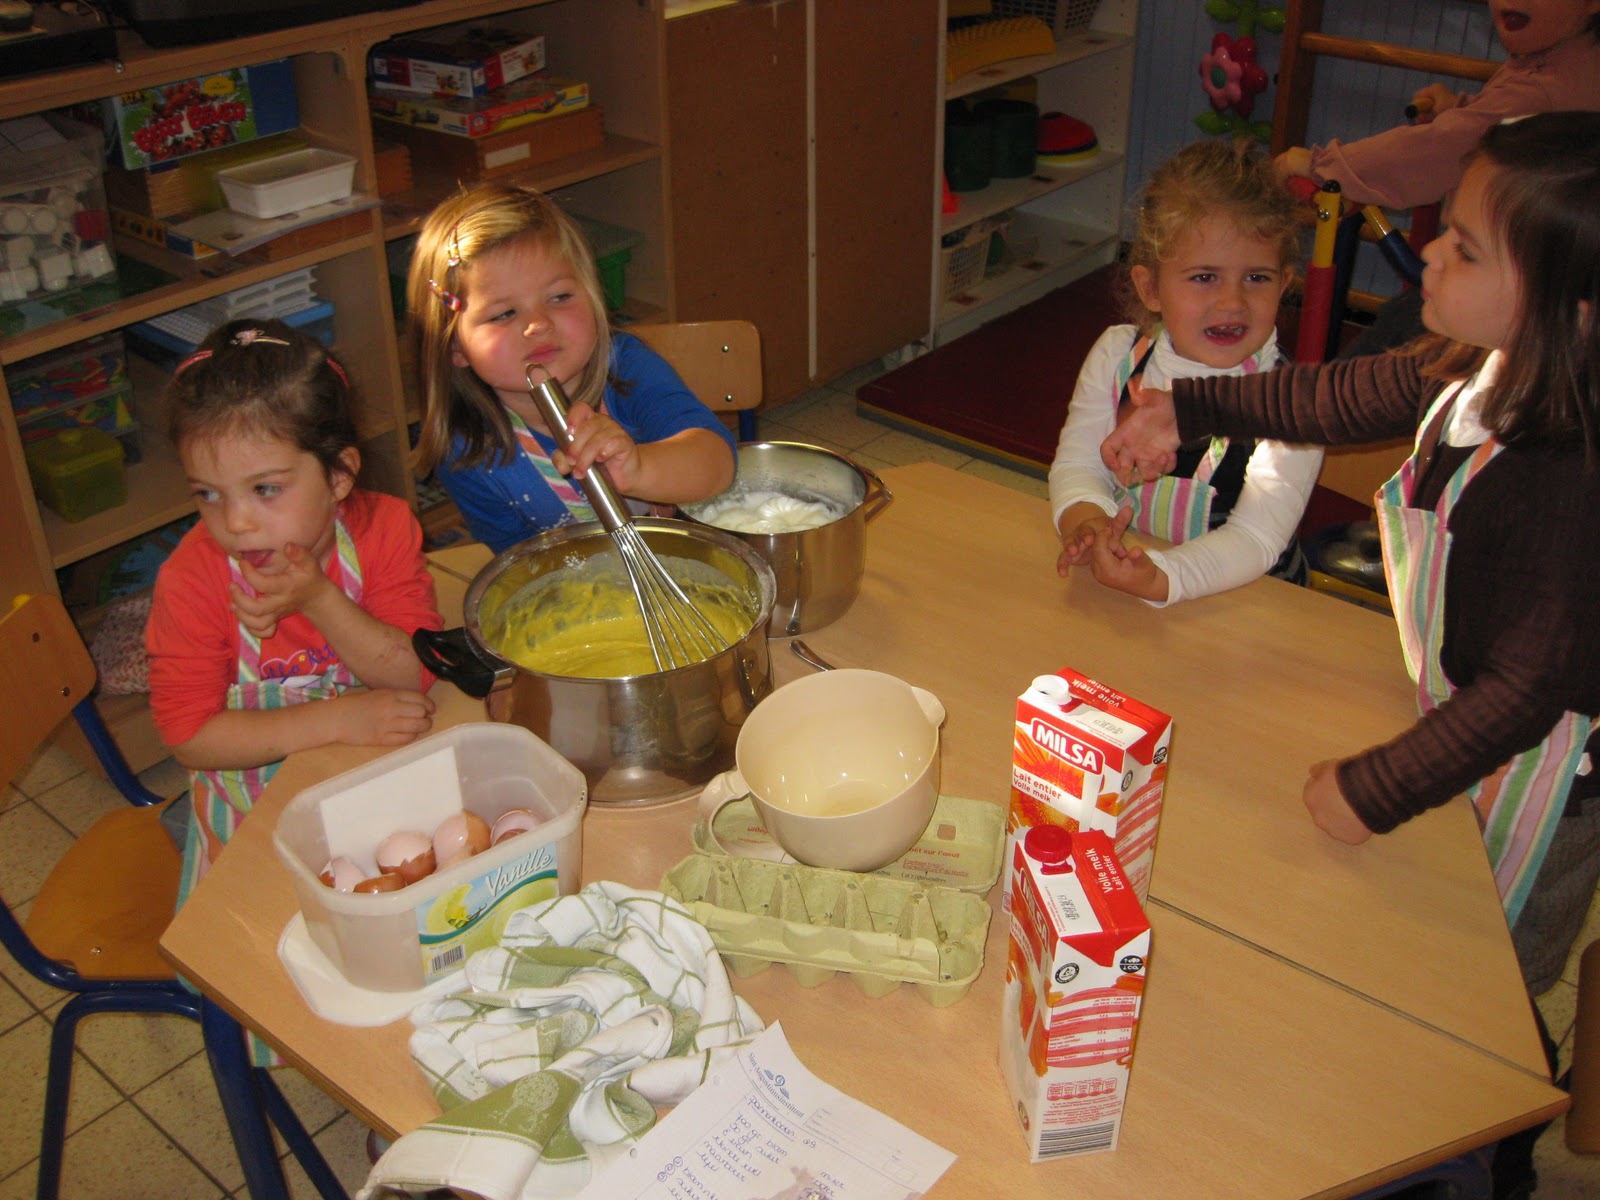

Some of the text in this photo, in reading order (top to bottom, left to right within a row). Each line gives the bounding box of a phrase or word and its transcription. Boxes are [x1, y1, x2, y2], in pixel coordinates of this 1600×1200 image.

[1072, 678, 1098, 695] melk
[1087, 678, 1127, 703] Lait entier
[1036, 724, 1099, 772] MILSA
[1013, 768, 1062, 800] Lait entier
[1013, 777, 1051, 803] Volle melk
[485, 847, 552, 897] Vanille
[1086, 847, 1112, 893] Volle melk
[1102, 855, 1125, 891] Lait entier
[1022, 876, 1048, 953] MSA
